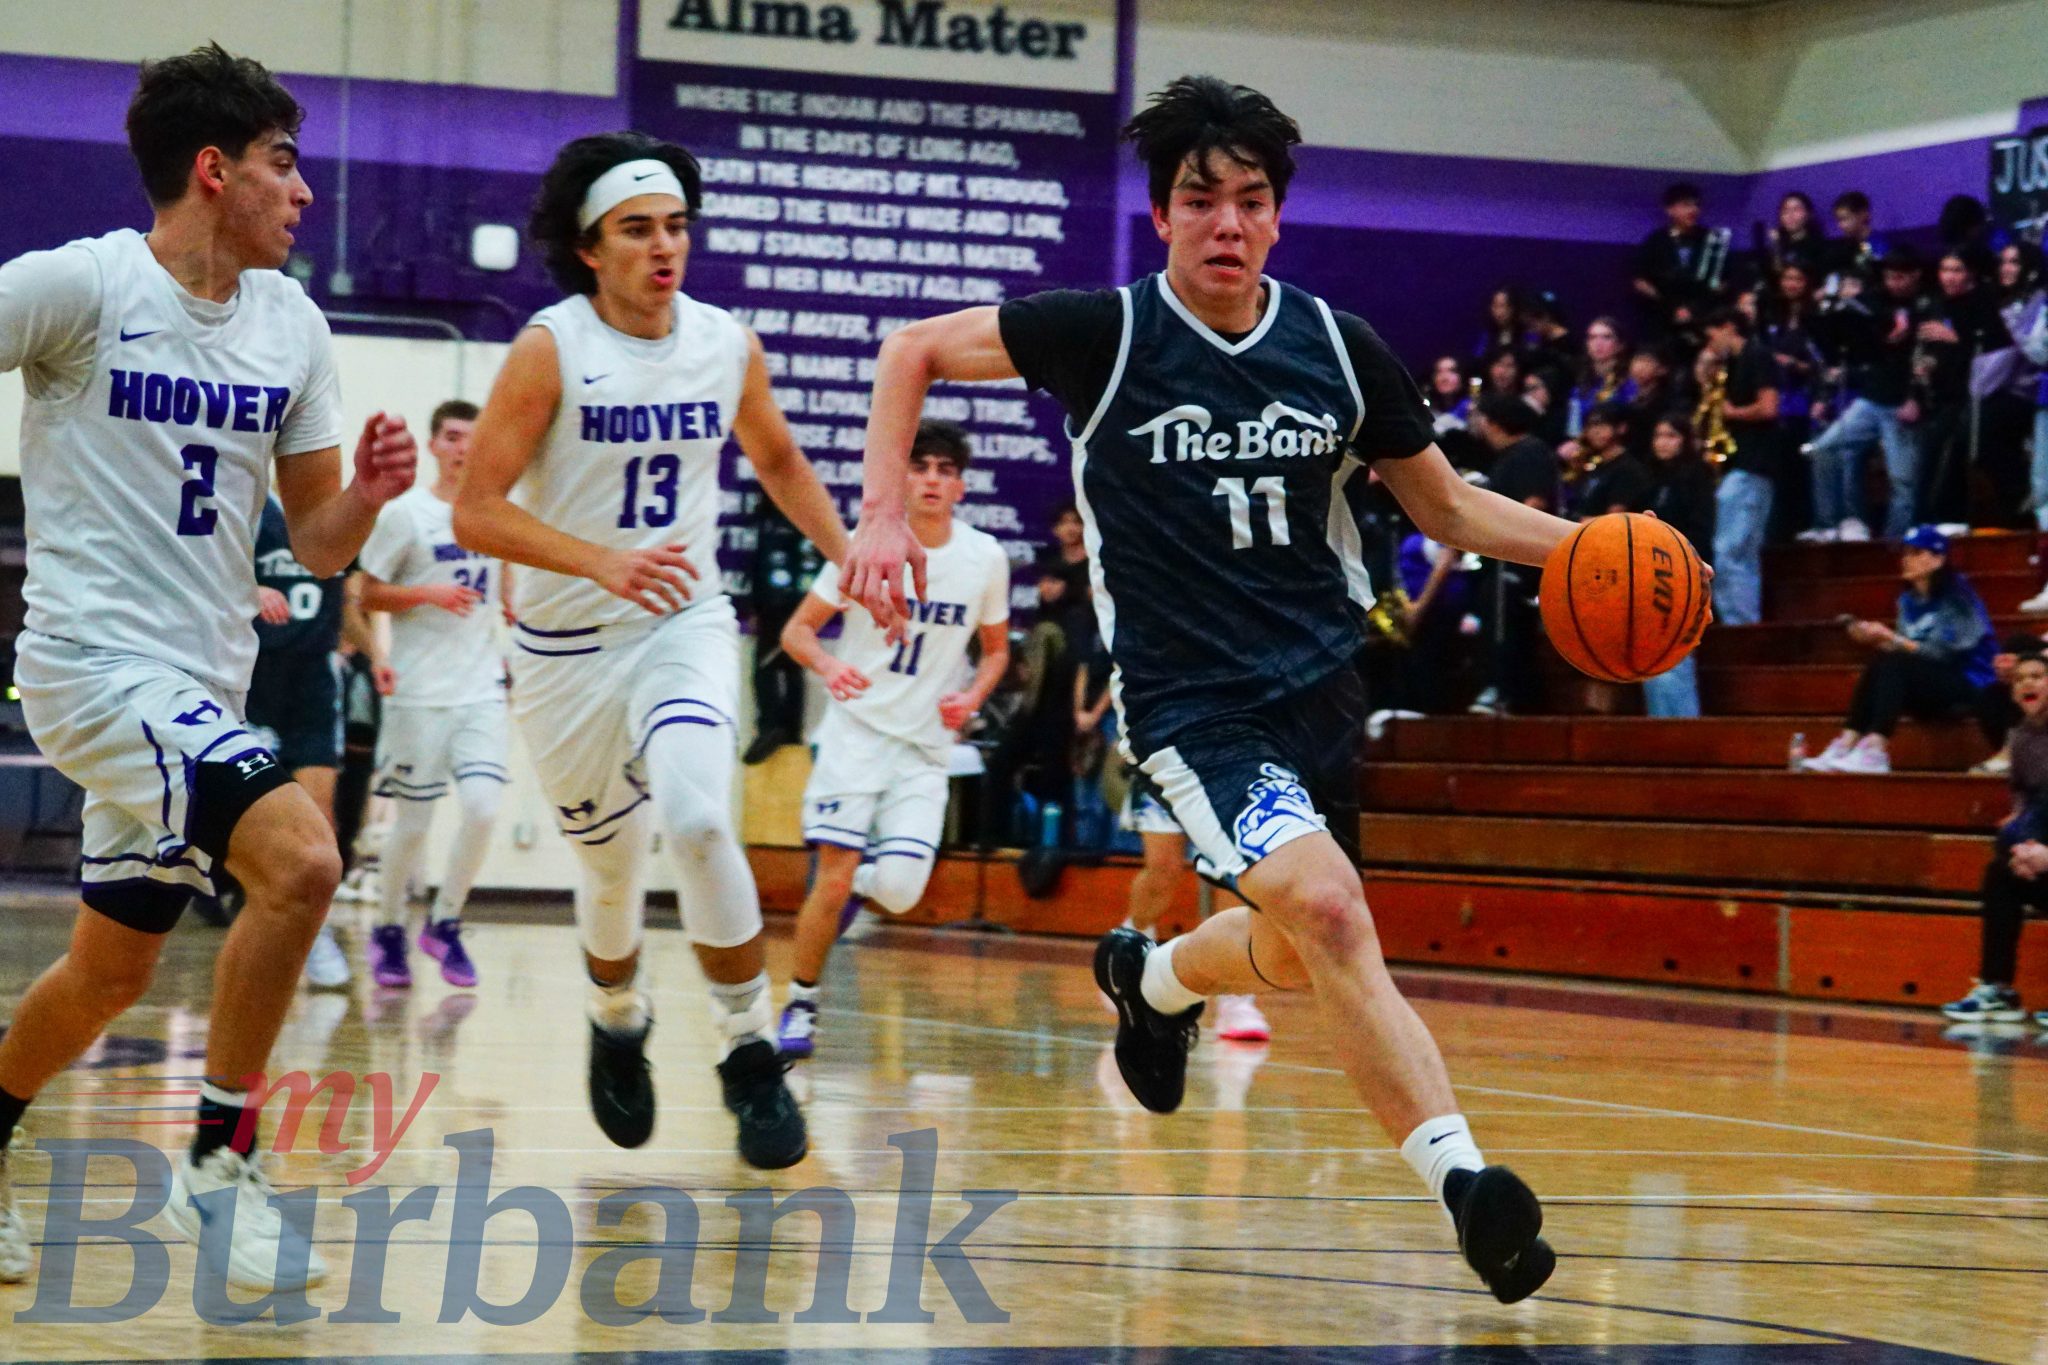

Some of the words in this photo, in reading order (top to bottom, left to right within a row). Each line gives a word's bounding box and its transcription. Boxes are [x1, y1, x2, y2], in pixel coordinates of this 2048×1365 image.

[668, 0, 859, 43] Alma
[875, 0, 1087, 59] Mater
[675, 84, 750, 113] WHERE
[756, 90, 798, 116] THE
[801, 94, 876, 121] INDIAN
[878, 98, 925, 125] AND
[929, 101, 968, 128] THE
[973, 104, 1086, 138] SPANIARD,
[740, 124, 766, 150] IN
[770, 126, 812, 153] THE
[815, 129, 872, 158] DAYS
[875, 133, 904, 159] OF
[907, 137, 966, 162] LONG
[968, 141, 1020, 171] AGO,
[758, 161, 801, 188] THE
[802, 164, 893, 195] HEIGHTS
[895, 170, 926, 197] OF
[965, 176, 1070, 209] VERDUGO,
[782, 198, 827, 224] THE
[826, 202, 906, 229] VALLEY
[905, 206, 962, 233] WIDE
[963, 210, 1011, 236] AND
[1012, 213, 1065, 243] LOW,
[707, 228, 761, 254] NOW
[763, 230, 849, 260] STANDS
[851, 236, 898, 263] OUR
[900, 239, 963, 266] ALMA
[962, 243, 1043, 275] MATER,
[744, 264, 772, 289] IN
[773, 267, 819, 292] HER
[821, 269, 923, 299] MAJESTY
[790, 354, 857, 380] NAME
[109, 368, 291, 433] HOOVER
[580, 401, 722, 443] HOOVER
[973, 398, 1037, 429] TRUE,
[1127, 404, 1232, 464] The
[177, 444, 219, 536] 2
[617, 454, 681, 529] 13
[1212, 476, 1291, 550] 11
